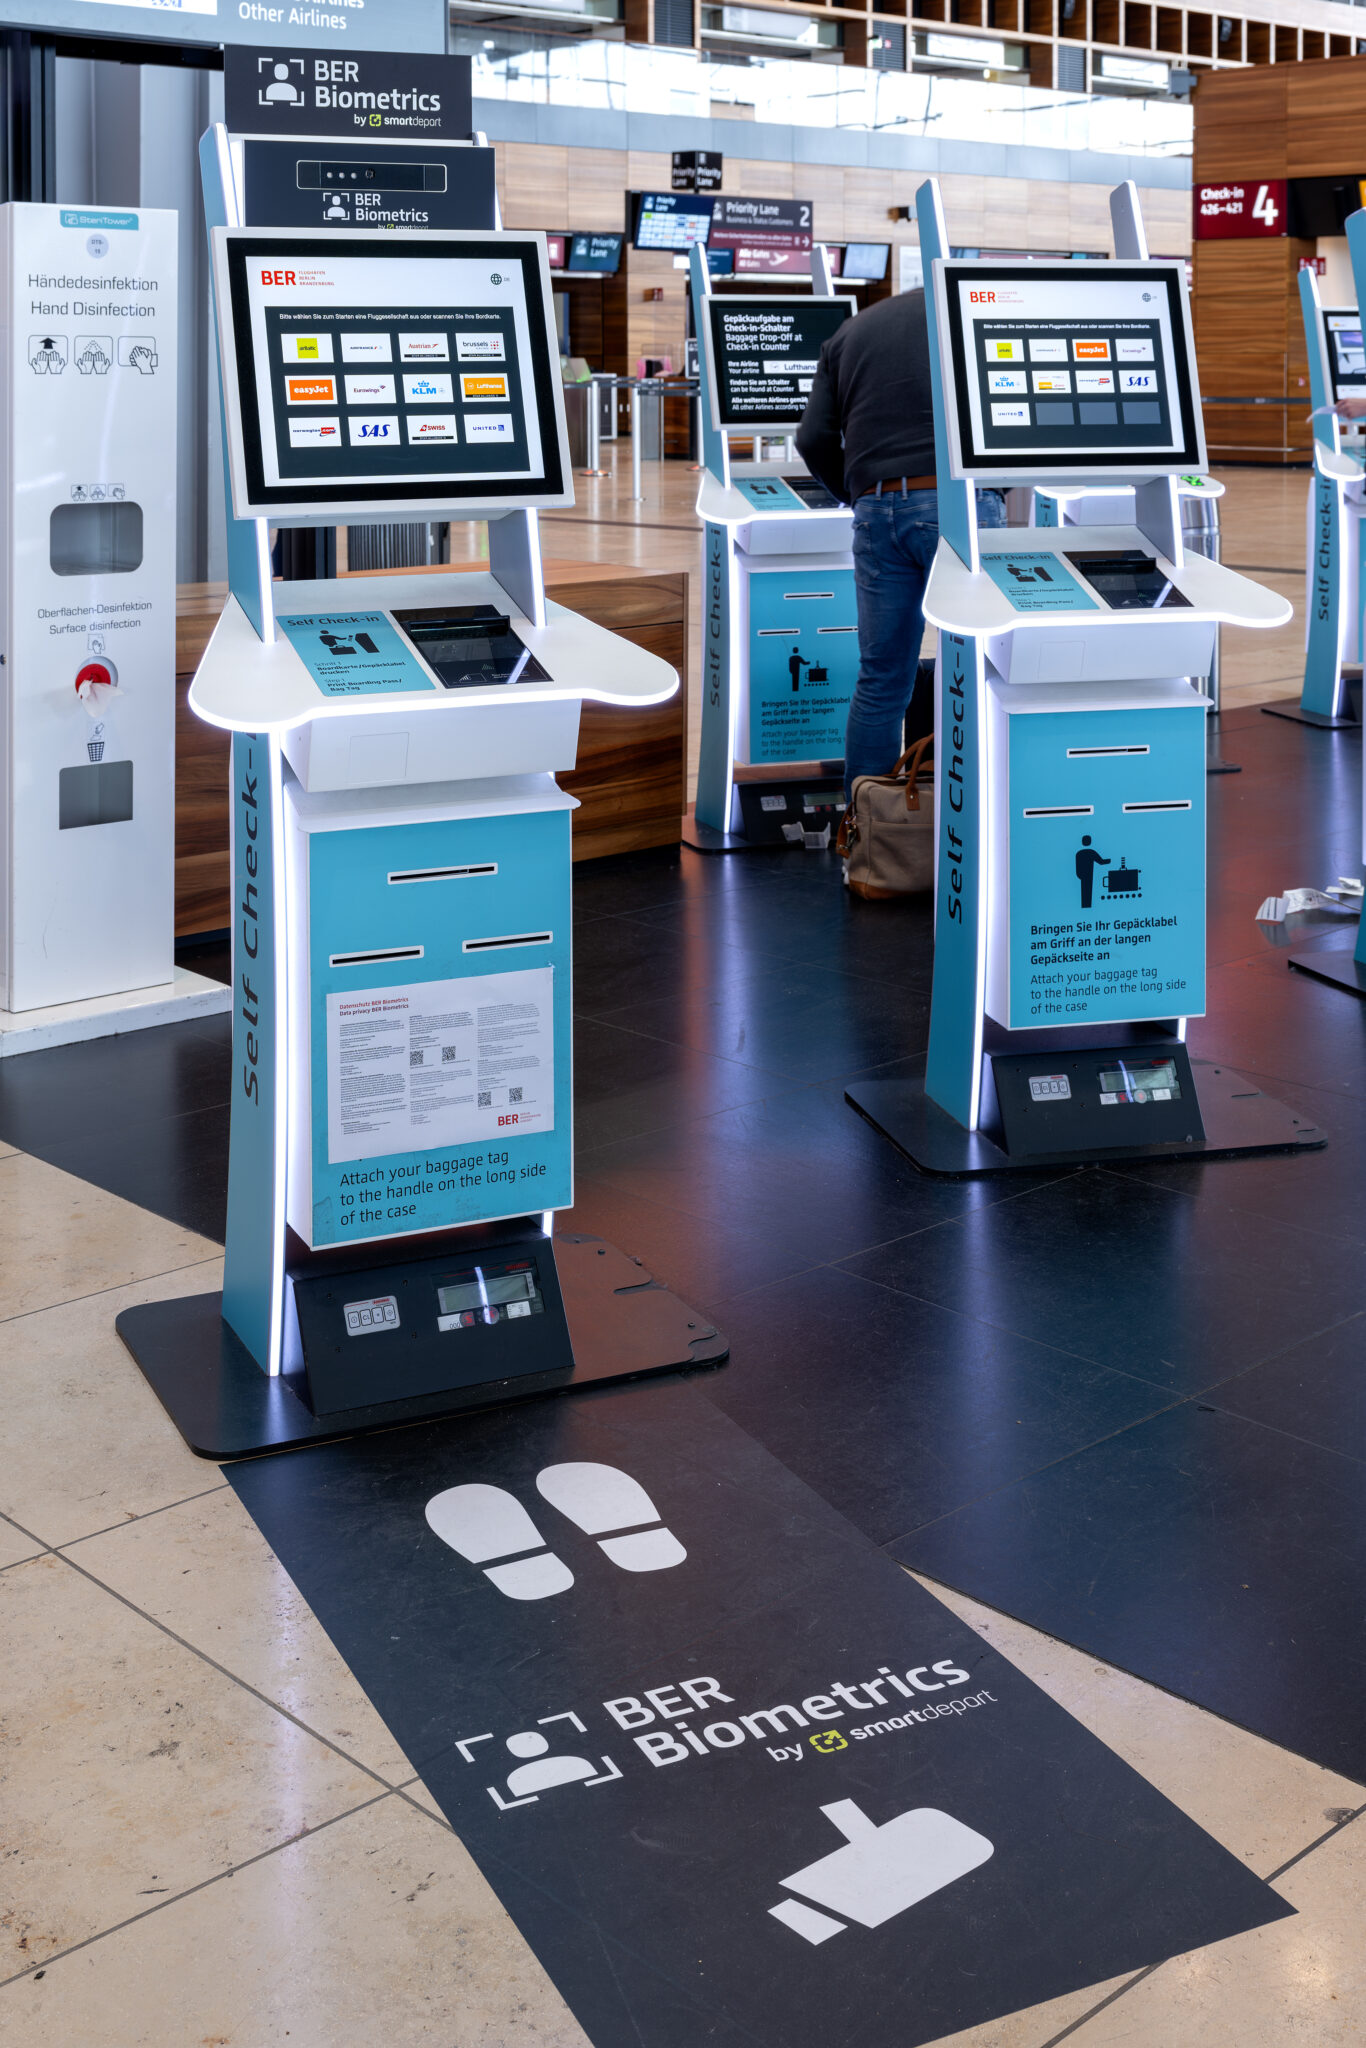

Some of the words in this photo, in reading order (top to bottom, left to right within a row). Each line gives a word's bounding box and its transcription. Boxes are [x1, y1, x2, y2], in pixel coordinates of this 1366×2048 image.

[238, 2, 284, 23] Other
[288, 7, 347, 30] Airlines
[314, 60, 359, 83] BER
[315, 85, 441, 112] Biometrics
[354, 114, 367, 127] by
[384, 115, 441, 128] smartdepart
[697, 167, 722, 180] Priority
[697, 178, 713, 187] Lane
[355, 193, 381, 206] BER
[1201, 186, 1245, 201] Check-in
[1252, 185, 1279, 226] 4
[355, 207, 429, 222] Biometrics
[726, 202, 759, 216] Priority
[760, 204, 780, 216] Lane
[799, 206, 810, 227] 2
[591, 238, 619, 249] Priority
[590, 248, 608, 257] Lane
[28, 274, 158, 291] Händedesinfektion
[261, 270, 297, 286] BER
[970, 291, 996, 303] BER
[31, 301, 69, 315] Hand
[73, 301, 155, 317] Disinfection
[723, 314, 781, 324] Gepäckaufgabe
[724, 324, 791, 332] Check-in-Schalter
[725, 333, 758, 343] Baggage
[759, 333, 793, 343] Drop-Off
[726, 343, 759, 351] Check-in
[760, 343, 790, 351] Counter
[1079, 346, 1105, 354] easyJet
[1126, 376, 1150, 386] SAS
[294, 385, 329, 394] easyJet
[412, 387, 437, 395] KLM
[358, 424, 391, 438] SAS
[710, 527, 721, 639] Check-i
[1318, 576, 1329, 621] Self
[37, 602, 153, 619] Oberflächen-Desinfektion
[49, 623, 87, 635] Surface
[89, 619, 141, 631] disinfection
[287, 618, 314, 627] Self
[319, 616, 380, 625] Check-in
[710, 648, 721, 708] Self
[948, 633, 965, 813] Check-i
[241, 732, 259, 960] Check-
[947, 824, 963, 925] Self
[1030, 923, 1073, 937] Bringen
[1077, 922, 1092, 932] Sie
[1095, 920, 1111, 931] Ihr
[1114, 916, 1177, 931] Gepäcklabel
[1030, 940, 1047, 950] am
[1050, 937, 1075, 949] Griff
[1078, 938, 1091, 947] an
[1094, 935, 1112, 946] der
[1115, 934, 1151, 946] langen
[1030, 951, 1094, 967] Gepäckseite
[1097, 951, 1110, 960] an
[1030, 972, 1064, 985] Attach
[1067, 971, 1091, 985] your
[1094, 969, 1138, 982] baggage
[1141, 967, 1158, 980] tag
[1030, 989, 1041, 1000] to
[1045, 987, 1062, 998] the
[1065, 985, 1101, 997] handle
[1104, 985, 1117, 995] on
[1120, 982, 1137, 993] the
[1140, 981, 1163, 993] long
[1166, 978, 1187, 990] side
[352, 1008, 371, 1016] privacy
[1030, 1003, 1043, 1015] of
[1045, 1002, 1062, 1013] the
[1065, 1002, 1088, 1012] case
[241, 973, 260, 1107] Self
[497, 1113, 519, 1127] BER
[340, 1168, 384, 1187] Attach
[389, 1164, 421, 1183] your
[425, 1156, 483, 1175] baggage
[487, 1151, 509, 1165] tag
[340, 1193, 354, 1207] to
[359, 1189, 382, 1203] the
[386, 1181, 434, 1200] handle
[438, 1178, 455, 1191] on
[460, 1173, 482, 1188] the
[486, 1169, 516, 1184] long
[520, 1163, 547, 1179] side
[340, 1210, 355, 1226] of
[360, 1208, 383, 1223] the
[387, 1204, 417, 1218] case
[602, 1676, 735, 1731] BER
[632, 1660, 971, 1767] Biometrics
[766, 1743, 804, 1763] by
[850, 1688, 998, 1741] smartdepart
